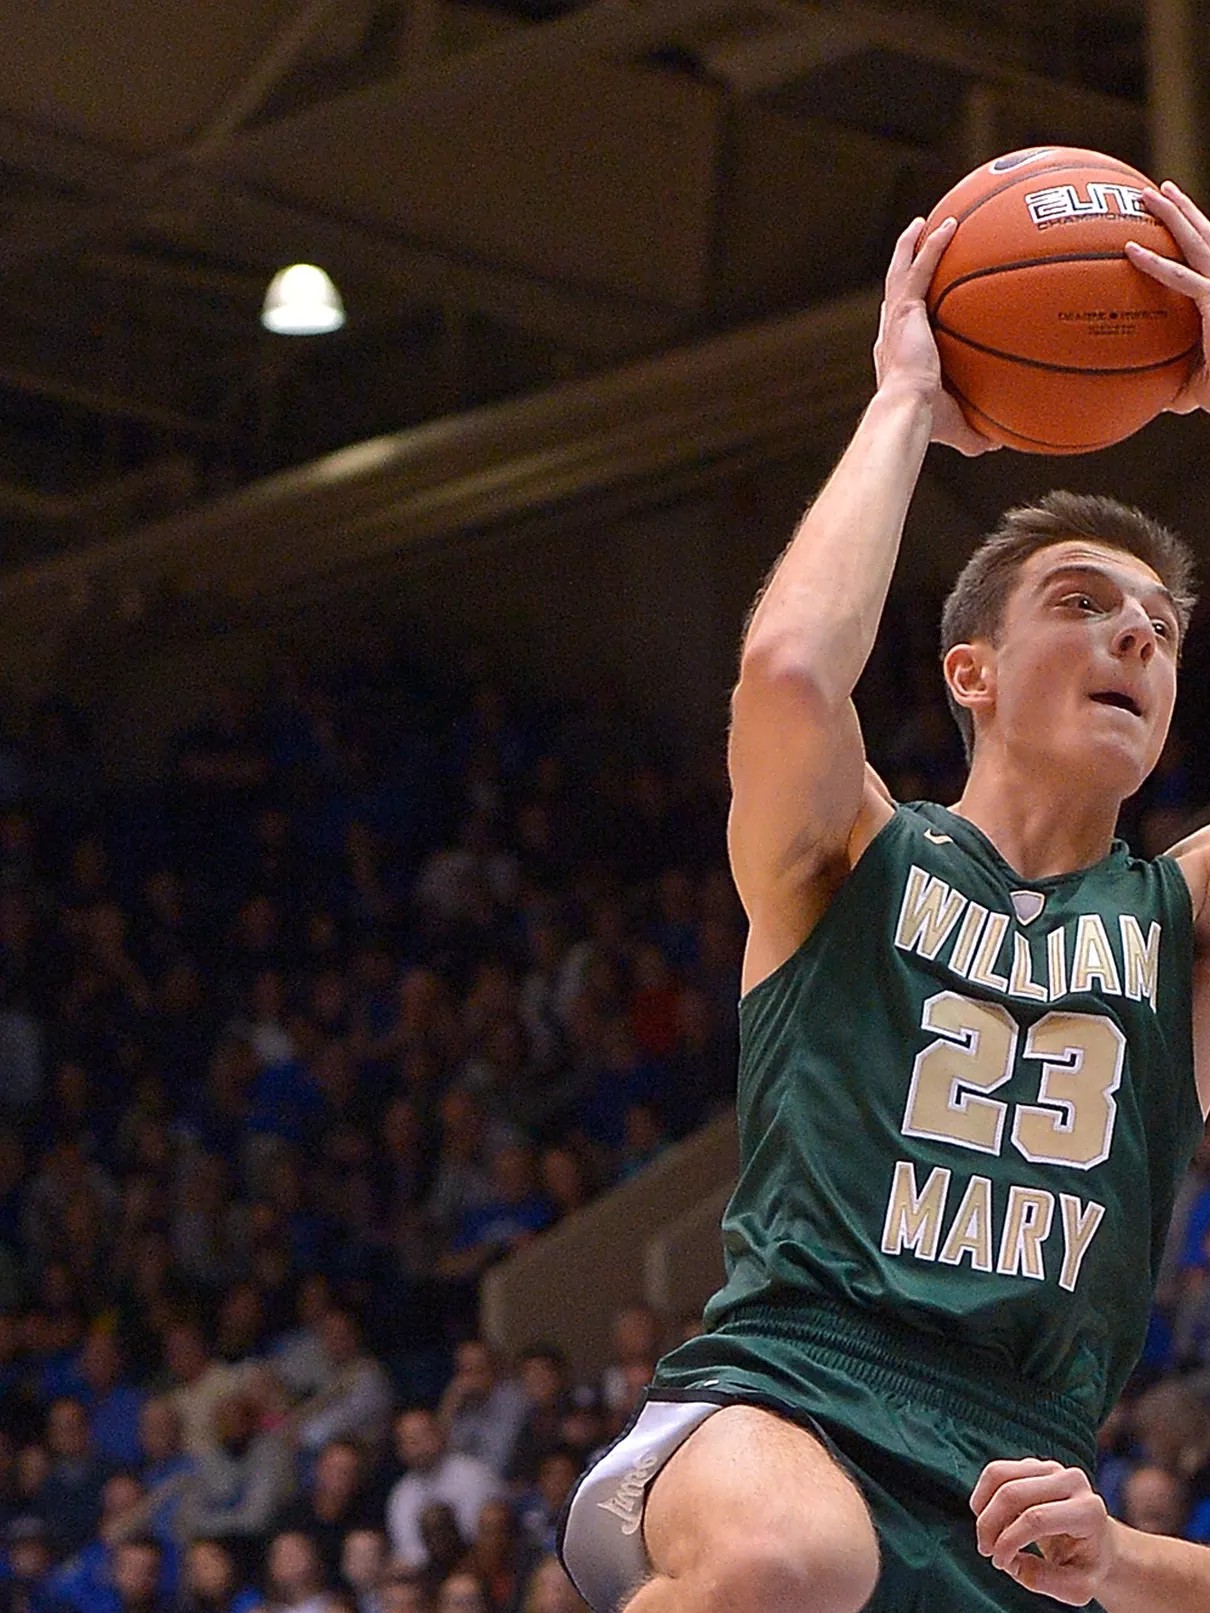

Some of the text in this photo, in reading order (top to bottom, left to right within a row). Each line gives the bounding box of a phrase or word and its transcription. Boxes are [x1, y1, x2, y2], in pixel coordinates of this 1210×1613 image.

[894, 864, 1162, 1014] WILLIAM
[900, 990, 1127, 1171] 23
[880, 1160, 1106, 1293] MARY
